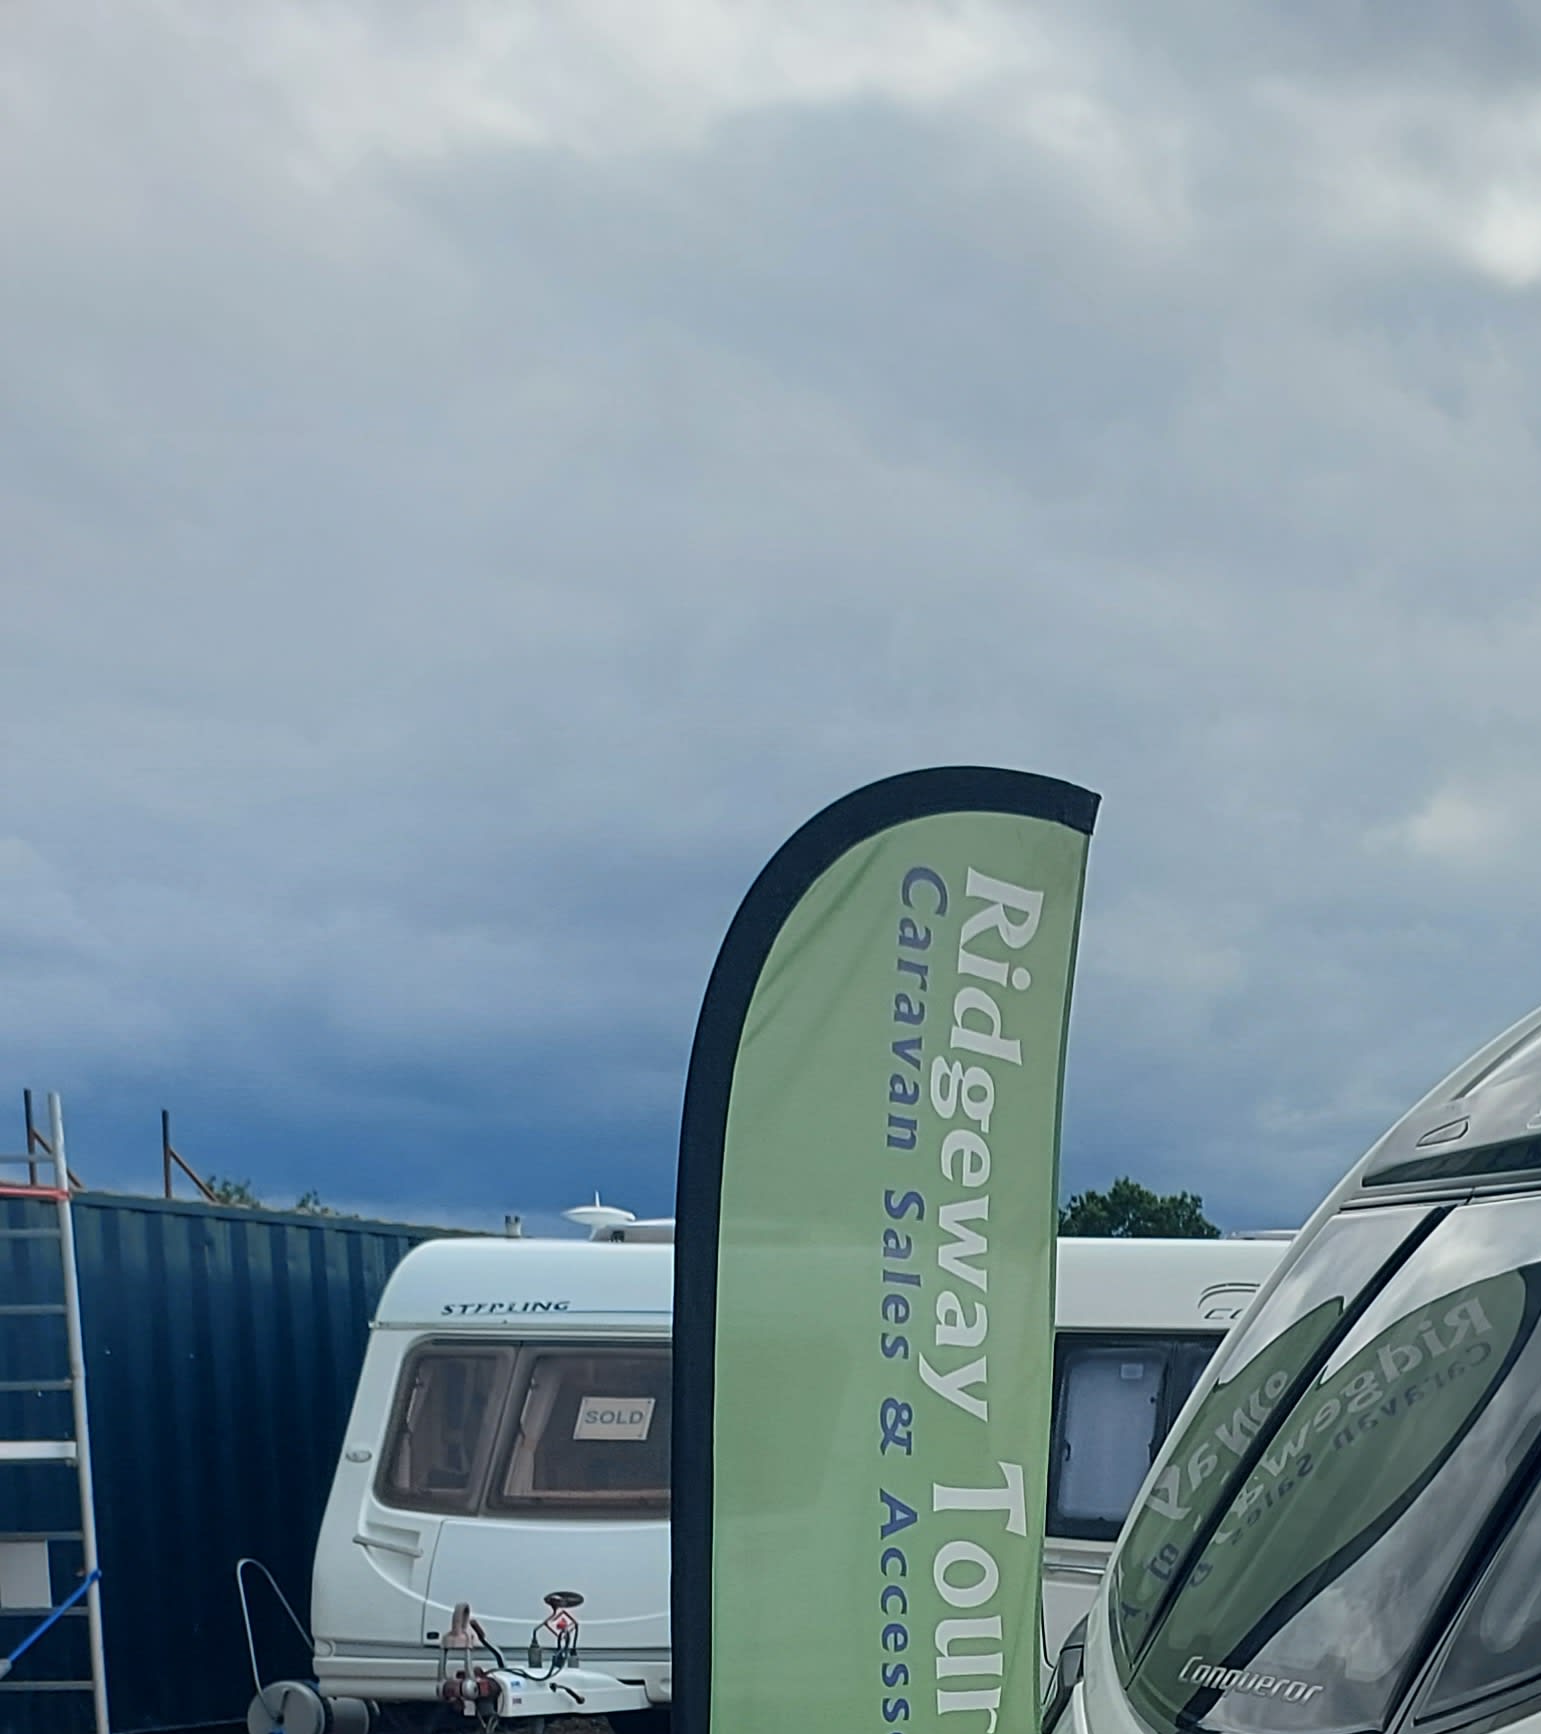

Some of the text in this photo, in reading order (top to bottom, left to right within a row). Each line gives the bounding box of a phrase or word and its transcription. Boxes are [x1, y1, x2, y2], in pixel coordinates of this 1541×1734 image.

[886, 866, 948, 1151] Caravan
[918, 866, 1045, 1423] Ridgeway
[881, 1190, 925, 1360] Sales
[584, 1410, 645, 1426] SOLD
[879, 1397, 912, 1456] &
[1178, 1655, 1324, 1705] Conqueror
